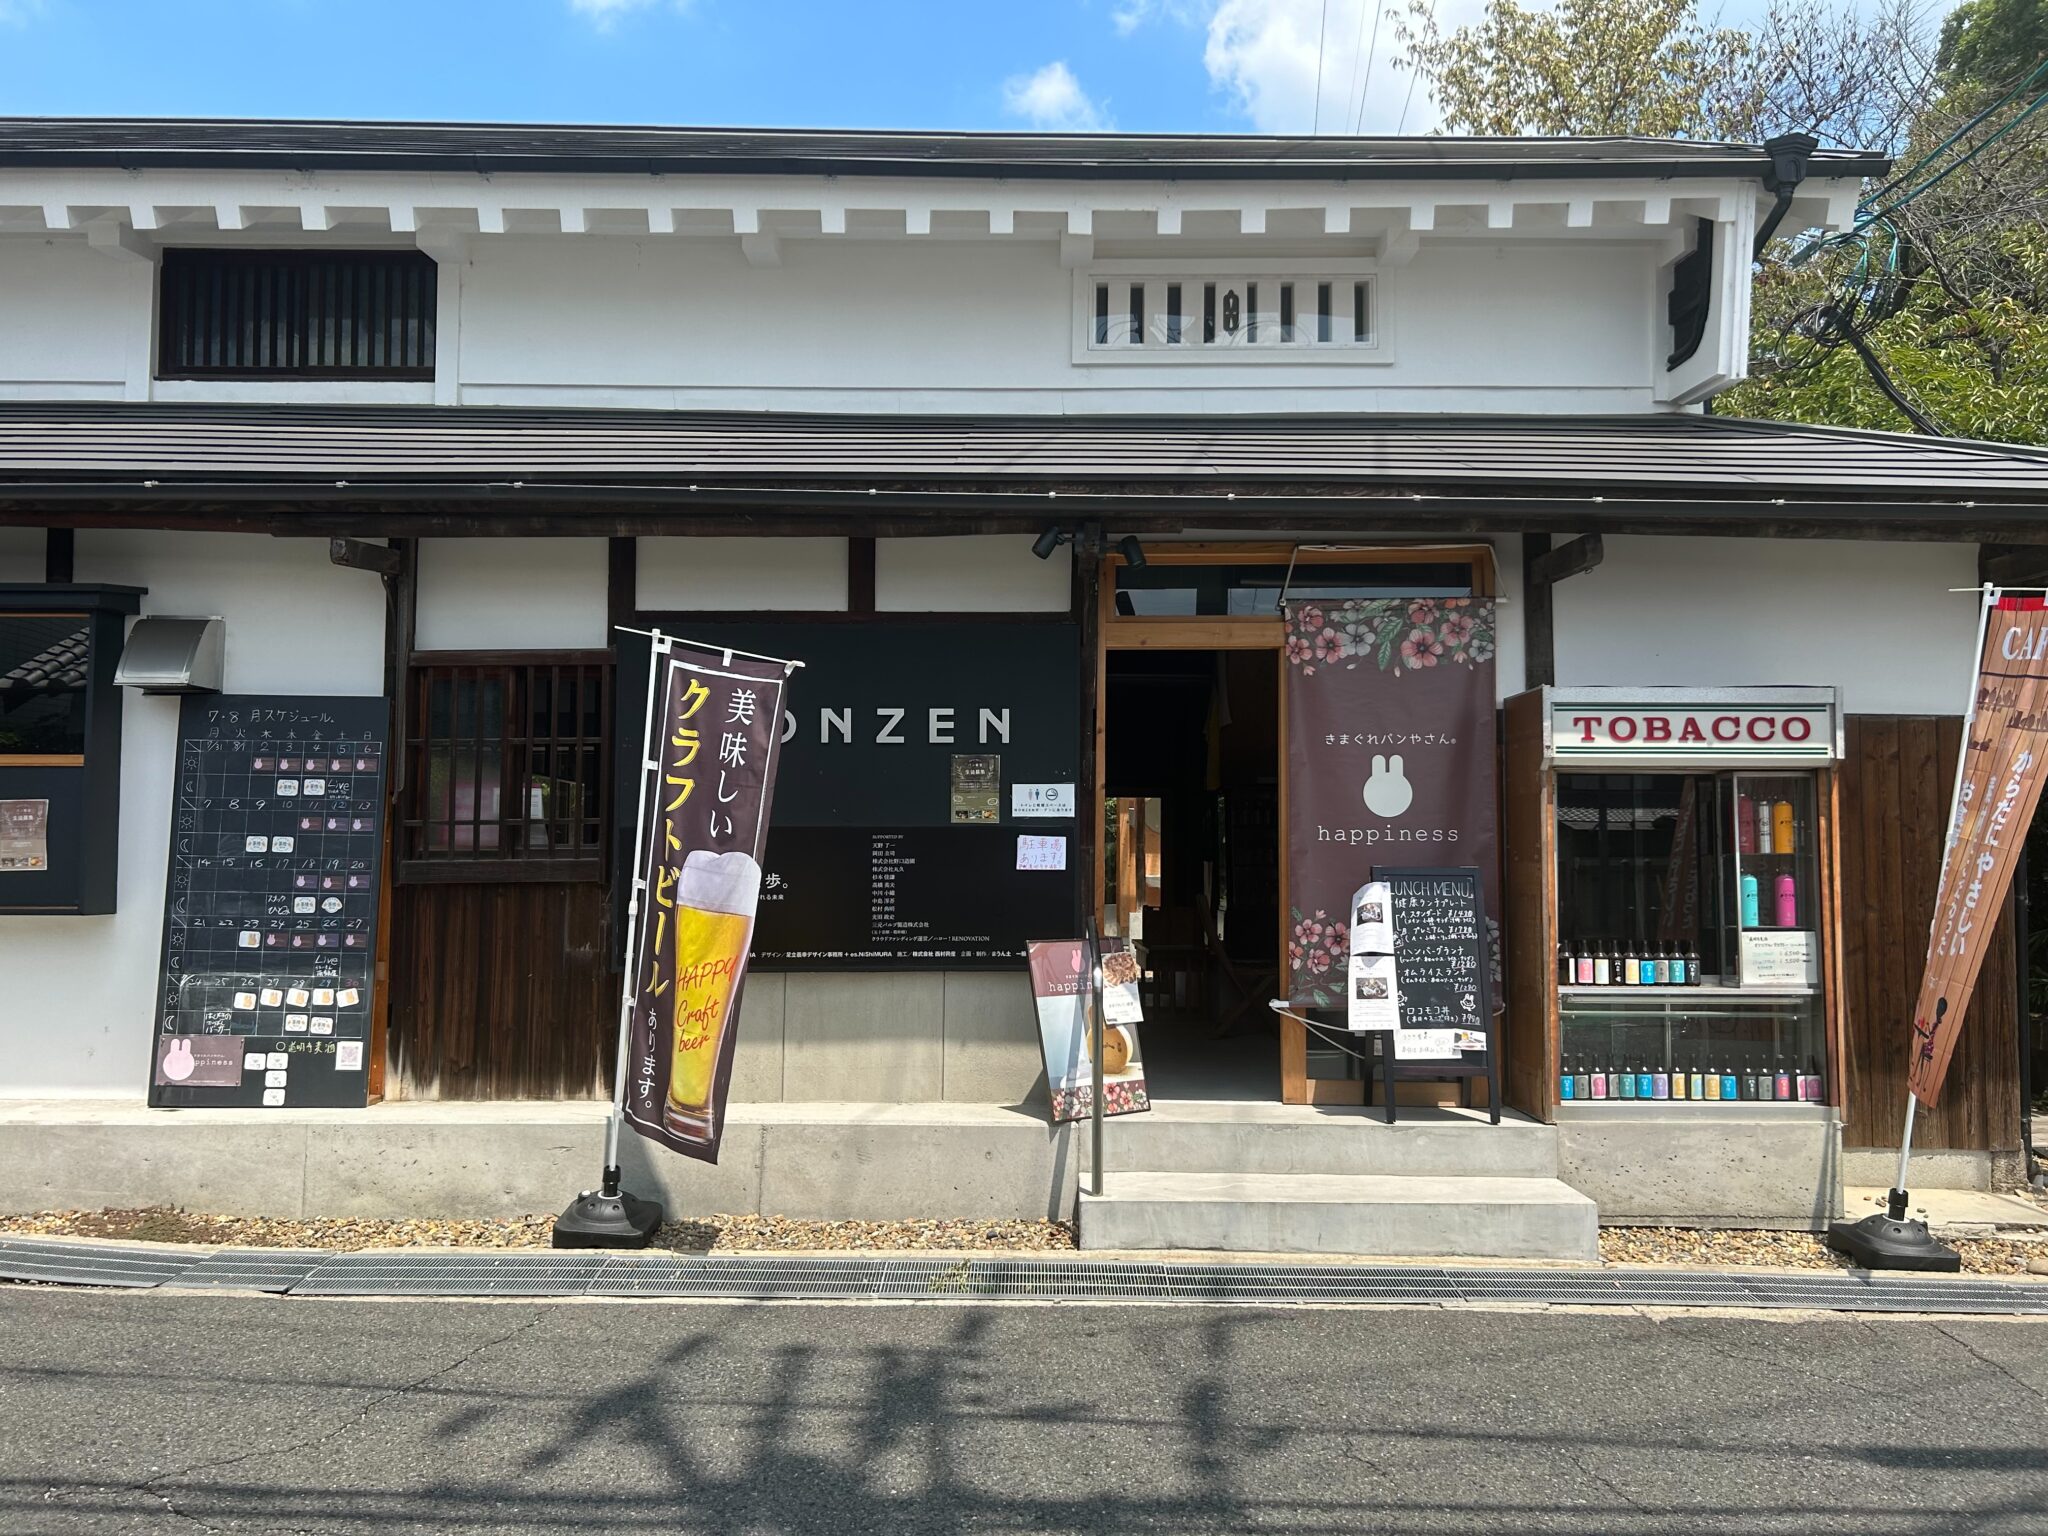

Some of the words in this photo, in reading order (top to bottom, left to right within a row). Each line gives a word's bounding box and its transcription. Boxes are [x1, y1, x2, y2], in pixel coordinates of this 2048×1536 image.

[209, 727, 220, 739] 月
[363, 731, 373, 740] 日
[1573, 716, 1812, 743] TOBACCO
[1324, 733, 1458, 745] きまぐれパンやさん。
[285, 742, 293, 752] 3
[312, 743, 321, 751] 4
[364, 744, 372, 753] 6
[710, 687, 756, 838] 美味しい
[327, 779, 350, 791] Live
[228, 798, 240, 809] 8
[256, 799, 266, 810] 9
[281, 801, 293, 809] 10
[645, 678, 711, 999] クラフトビール
[1317, 824, 1459, 845] happiness
[1949, 750, 2033, 956] からだにやさしい
[197, 857, 211, 868] 14
[249, 858, 264, 869] 16
[301, 858, 316, 869] 18
[326, 858, 340, 870] 19
[350, 860, 365, 870] 20
[1433, 881, 1470, 898] MENU
[193, 918, 206, 928] 21
[218, 919, 234, 927] 22
[243, 919, 259, 929] 23
[270, 919, 286, 930] 24
[295, 919, 312, 929] 25
[322, 919, 338, 928] 26
[346, 919, 363, 929] 27
[314, 954, 339, 966] Live
[241, 977, 255, 987] 26
[676, 956, 739, 993] HAPPY
[676, 998, 720, 1032] Craft
[678, 1032, 711, 1053] beer
